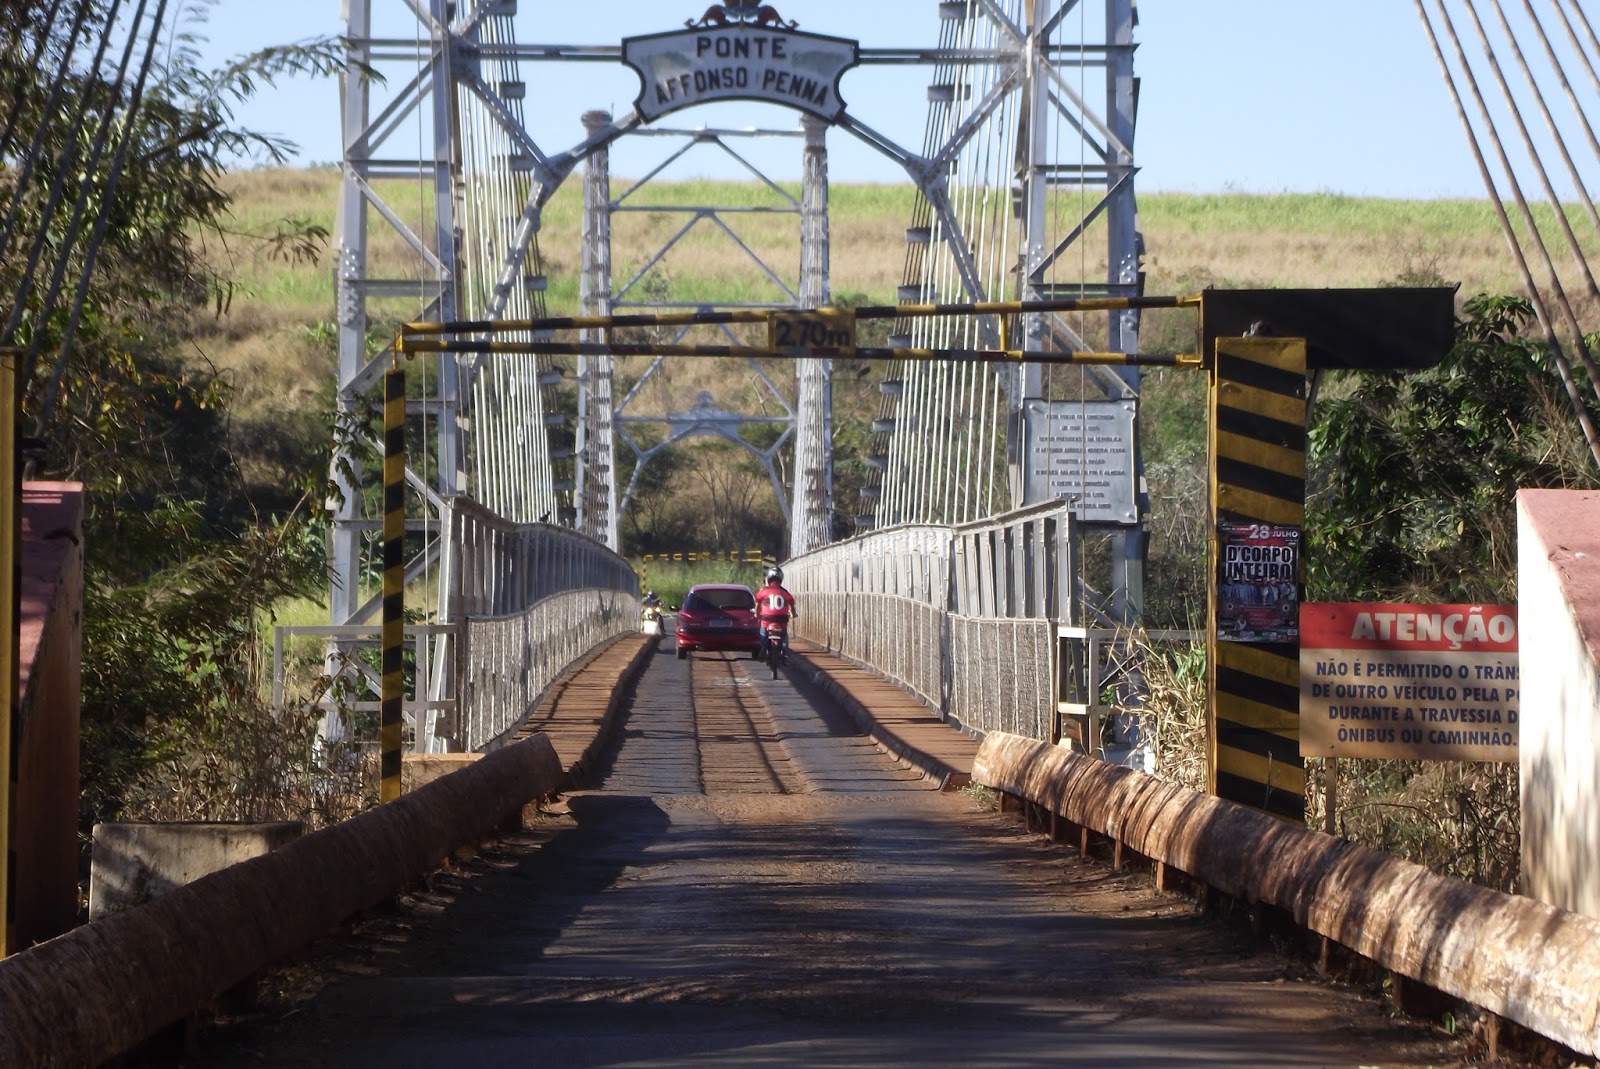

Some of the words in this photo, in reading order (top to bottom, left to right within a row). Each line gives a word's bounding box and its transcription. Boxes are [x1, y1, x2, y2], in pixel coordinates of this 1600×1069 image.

[697, 37, 787, 59] PONTE
[655, 67, 748, 105] AFFONSO
[762, 69, 829, 108] PENNA
[1249, 524, 1270, 539] 28
[768, 594, 785, 611] 10
[1351, 606, 1515, 650] ATENÇÃO
[1316, 658, 1348, 676] NÃO
[1353, 658, 1361, 676] É
[1366, 662, 1453, 679] PERMITIDO
[1458, 664, 1469, 679] O
[1474, 661, 1519, 680] TRÂN
[1312, 683, 1330, 698] DE
[1335, 684, 1388, 700] OUTRO
[1393, 682, 1457, 701] VEÍCULO
[1462, 687, 1500, 702] PELA
[1505, 688, 1519, 703] P
[1328, 705, 1399, 721] DURANTE
[1404, 707, 1415, 721] A
[1419, 707, 1502, 724] TRAVESSIA
[1337, 723, 1395, 743] ÔNIBUS
[1401, 729, 1423, 744] OU
[1428, 727, 1517, 747] CAMINHÃO.
